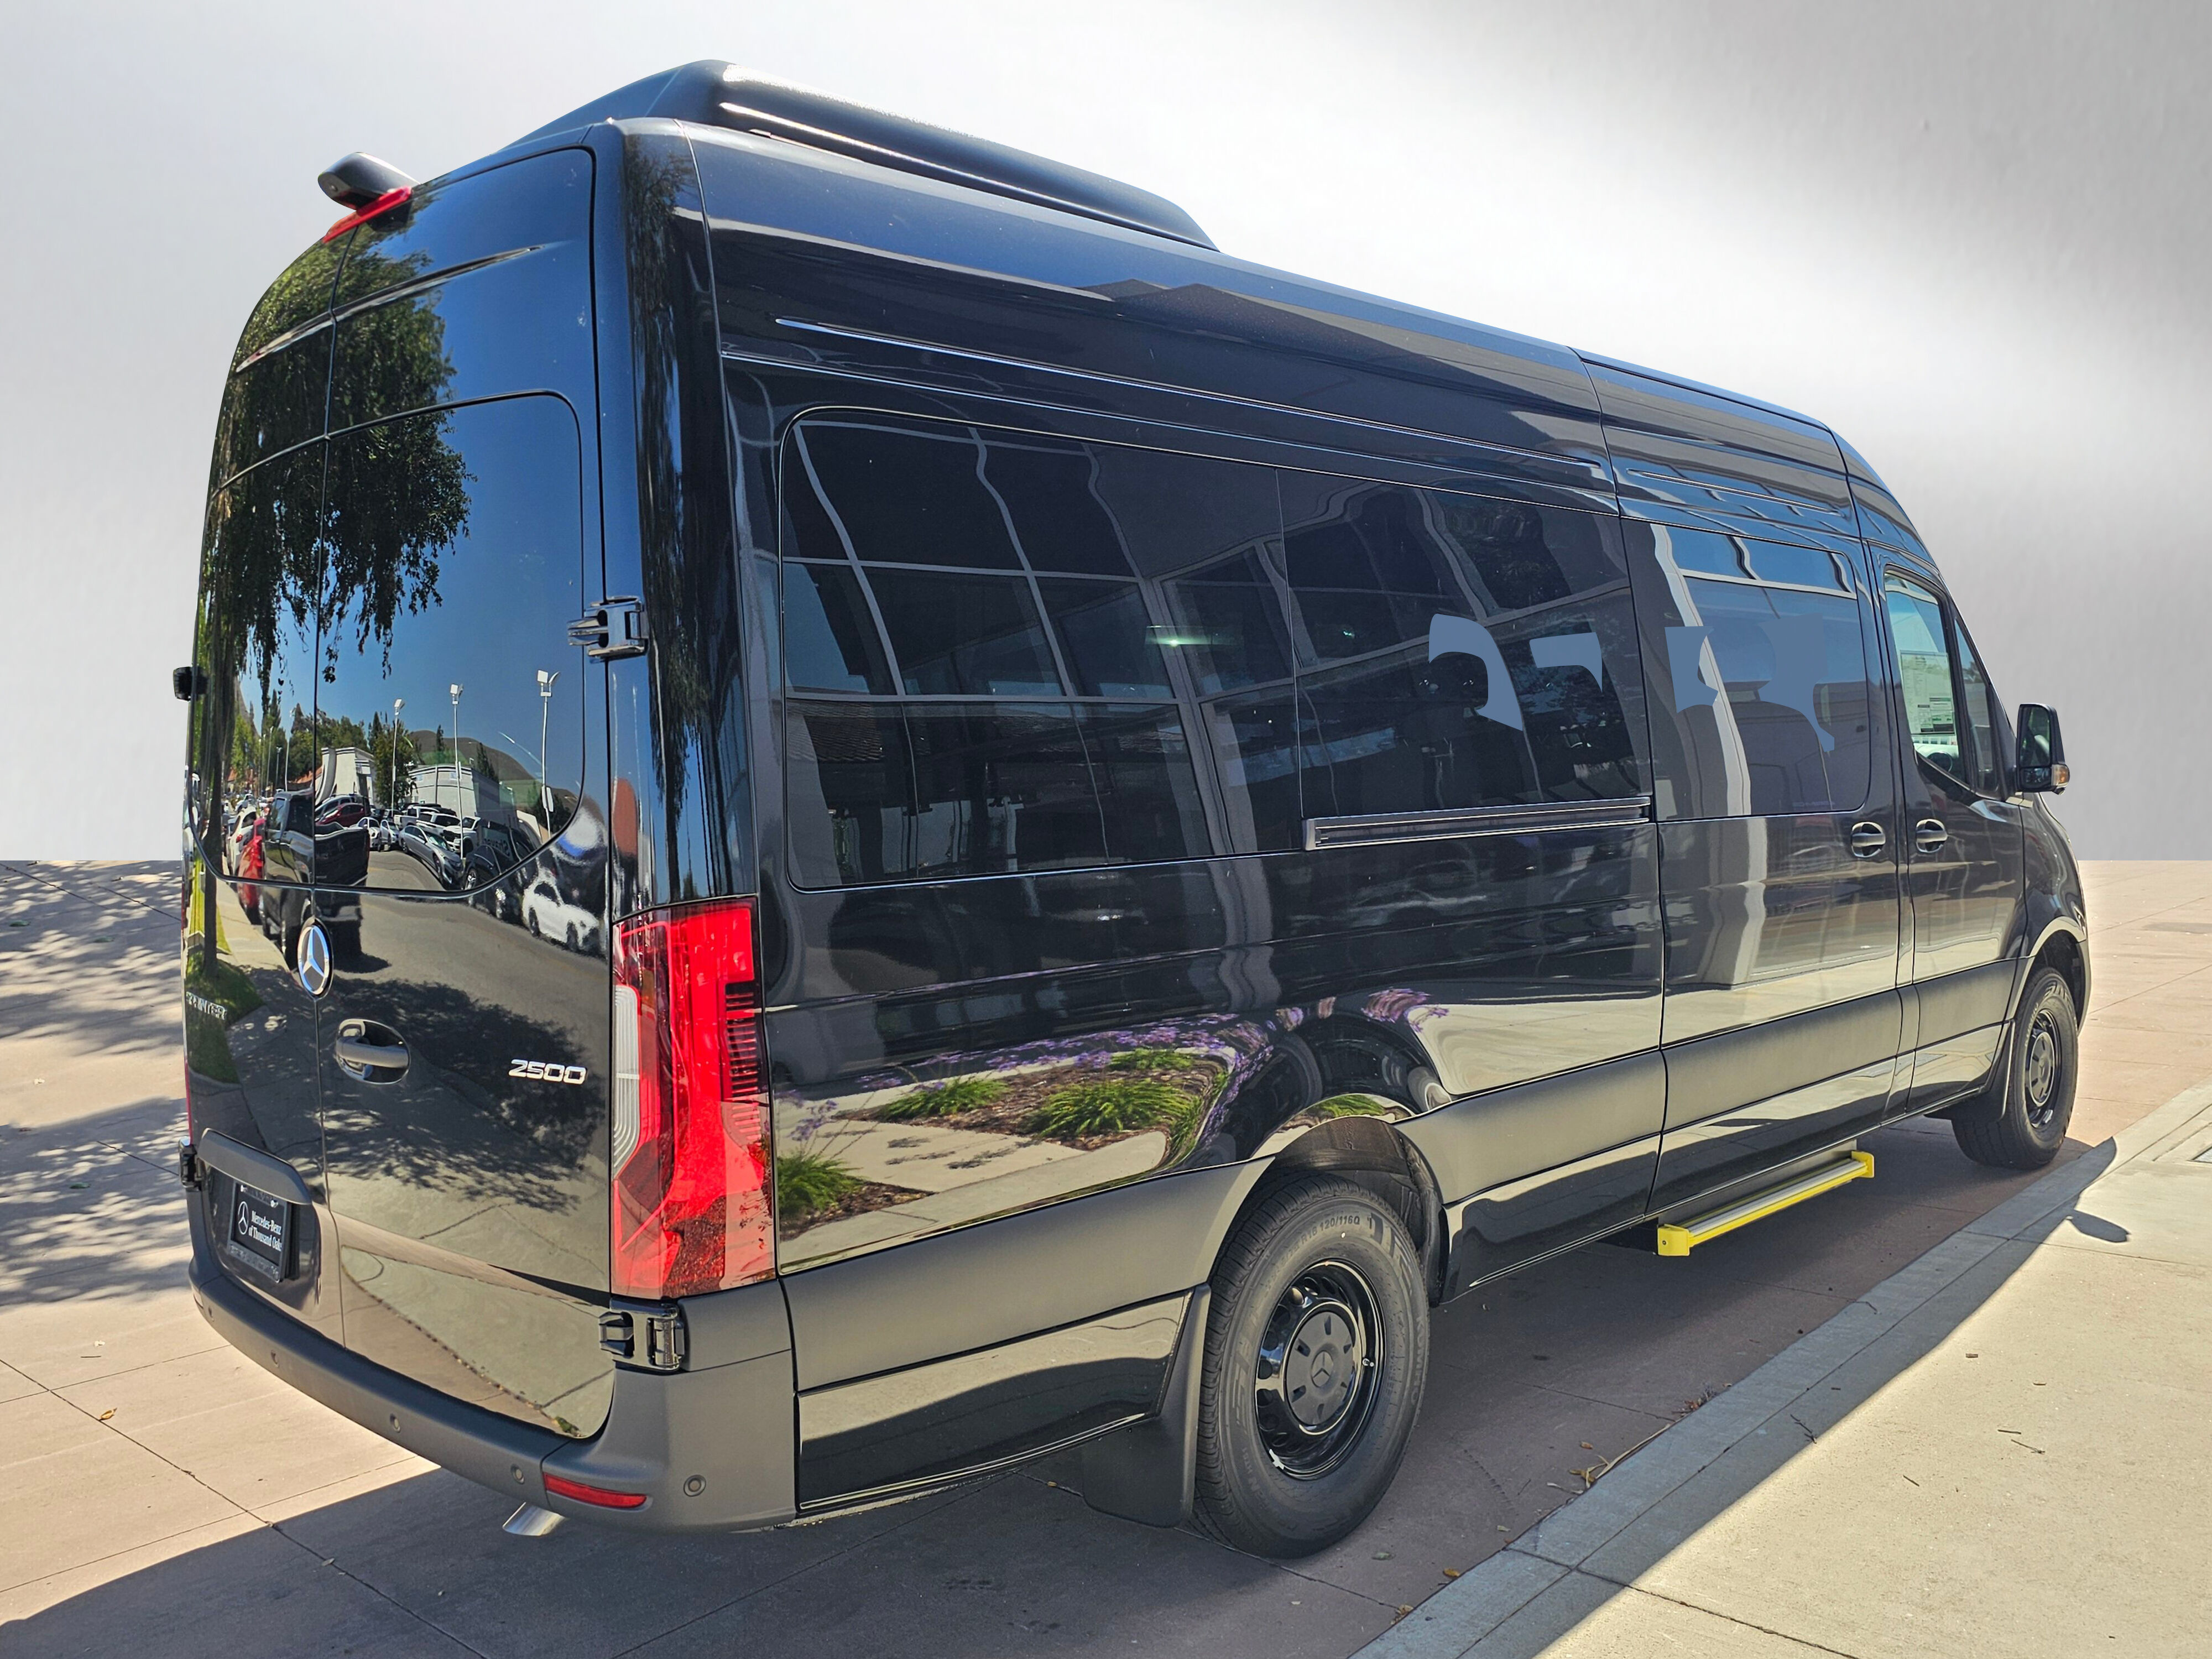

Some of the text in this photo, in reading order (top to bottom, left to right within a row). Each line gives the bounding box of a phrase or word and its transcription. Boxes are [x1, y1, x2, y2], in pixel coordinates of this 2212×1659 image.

[508, 1059, 587, 1084] 2500
[251, 1210, 282, 1235] Mercedes-Benz
[248, 1225, 253, 1237] of
[253, 1226, 272, 1247] Thousand
[1411, 1315, 1425, 1406] KUMHO
